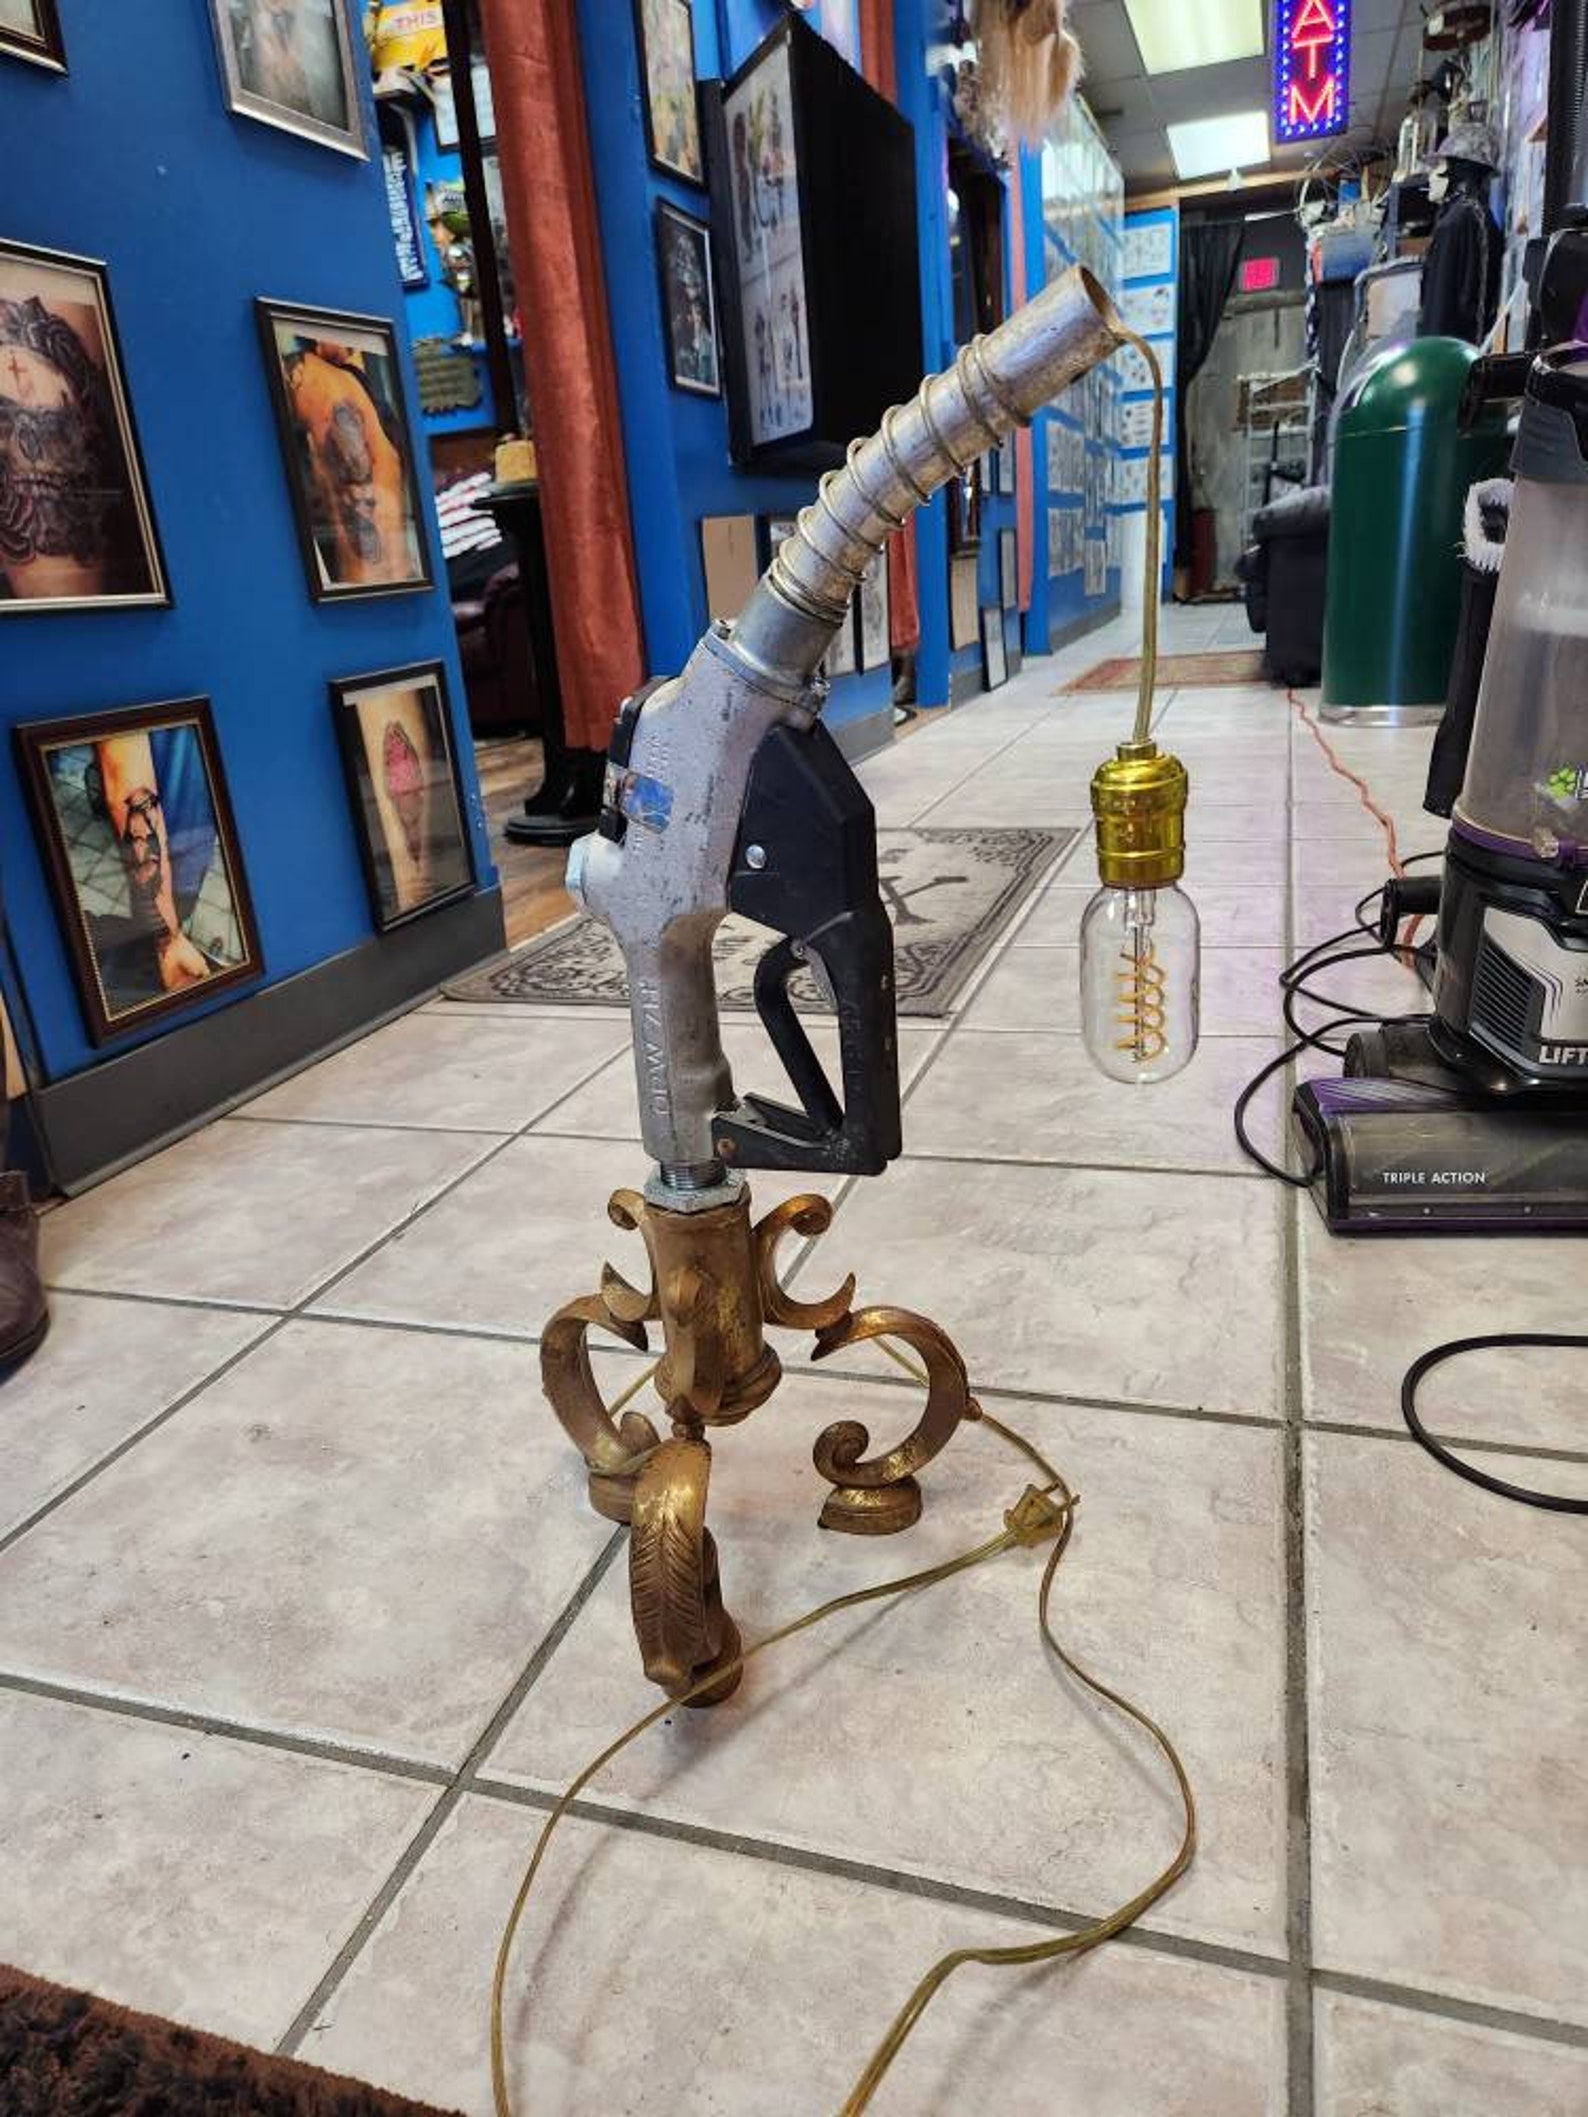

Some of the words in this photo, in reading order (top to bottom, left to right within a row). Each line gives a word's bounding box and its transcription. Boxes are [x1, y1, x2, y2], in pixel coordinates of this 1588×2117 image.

[393, 9, 438, 30] THIS
[1289, 0, 1335, 125] ATM
[1382, 1171, 1426, 1185] TRIPLE
[1431, 1171, 1486, 1185] ACTION
